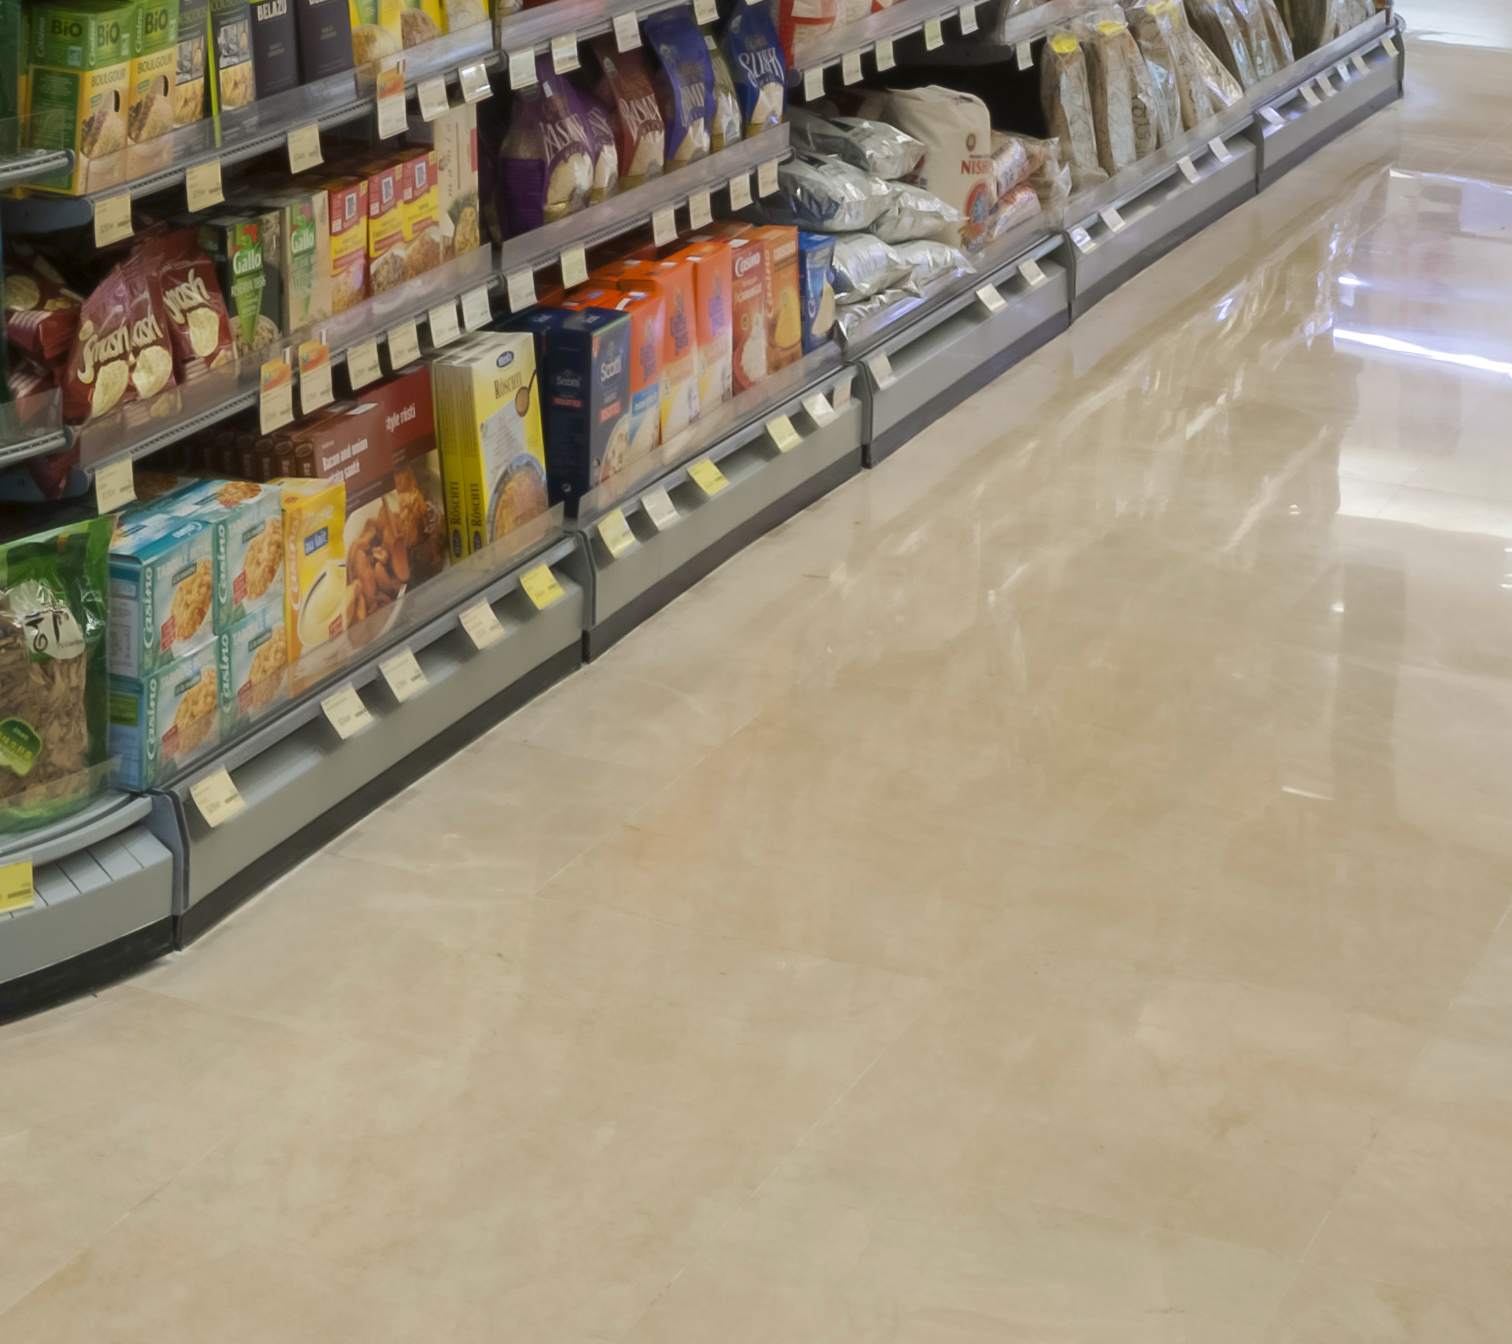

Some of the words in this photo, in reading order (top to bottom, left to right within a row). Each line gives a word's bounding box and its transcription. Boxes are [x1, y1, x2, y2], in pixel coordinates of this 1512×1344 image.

[144, 7, 169, 36] BiO
[90, 67, 126, 89] BOULGOUR
[136, 52, 174, 75] BOULGOUR
[290, 229, 315, 256] Gallo
[233, 245, 262, 276] Gallo
[735, 250, 761, 277] Casino
[493, 371, 524, 400] RÖSCHTI
[556, 375, 582, 387] Scotti
[600, 359, 622, 384] Scotti
[322, 450, 340, 472] Bacon
[340, 447, 351, 466] and
[351, 437, 369, 461] onion
[450, 480, 461, 527] RÖSCHTI
[470, 483, 480, 529] RÖSCHTI
[143, 566, 153, 649] Casino
[221, 633, 231, 713] Casino
[146, 677, 157, 761] Casino
